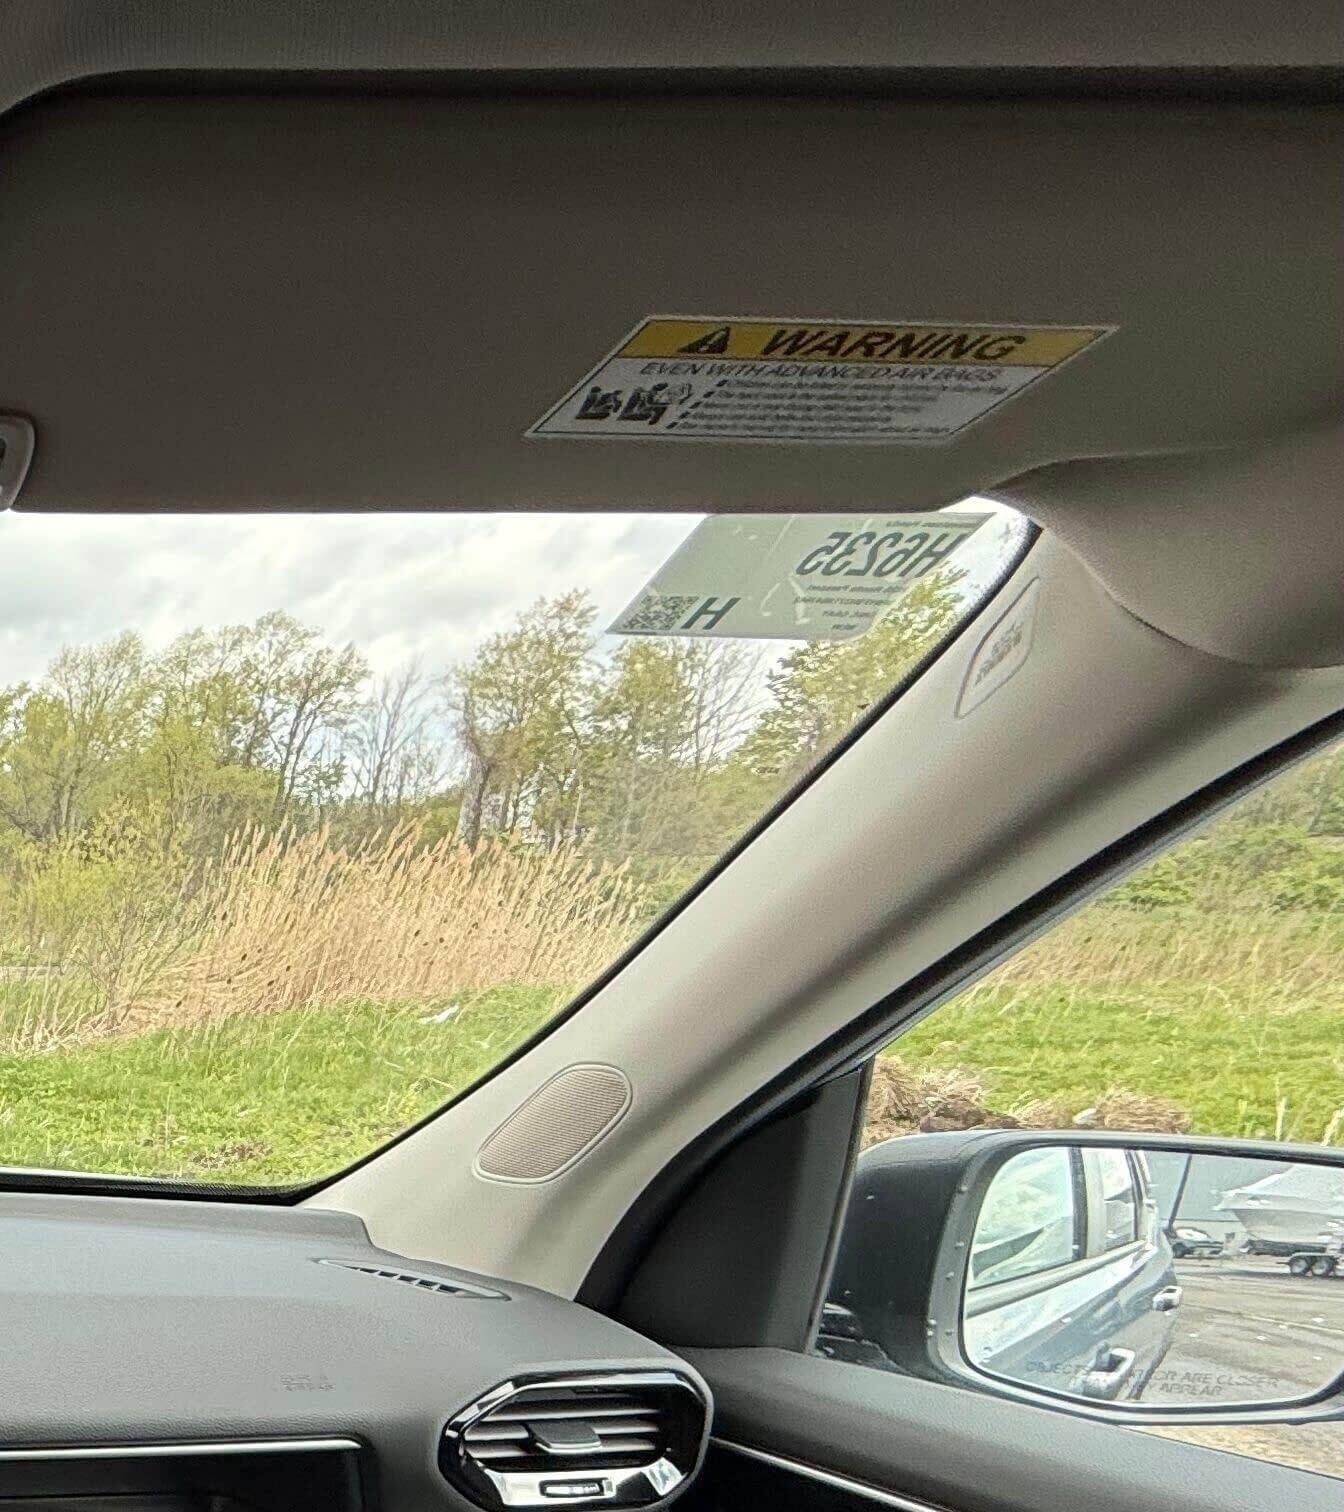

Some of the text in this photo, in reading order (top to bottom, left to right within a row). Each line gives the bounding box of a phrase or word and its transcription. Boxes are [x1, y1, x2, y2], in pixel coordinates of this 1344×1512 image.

[759, 328, 1027, 360] WARNING
[640, 362, 705, 375] EVEN
[704, 363, 767, 376] WITH
[765, 365, 893, 378] ADVANCED
[890, 367, 934, 379] AIR
